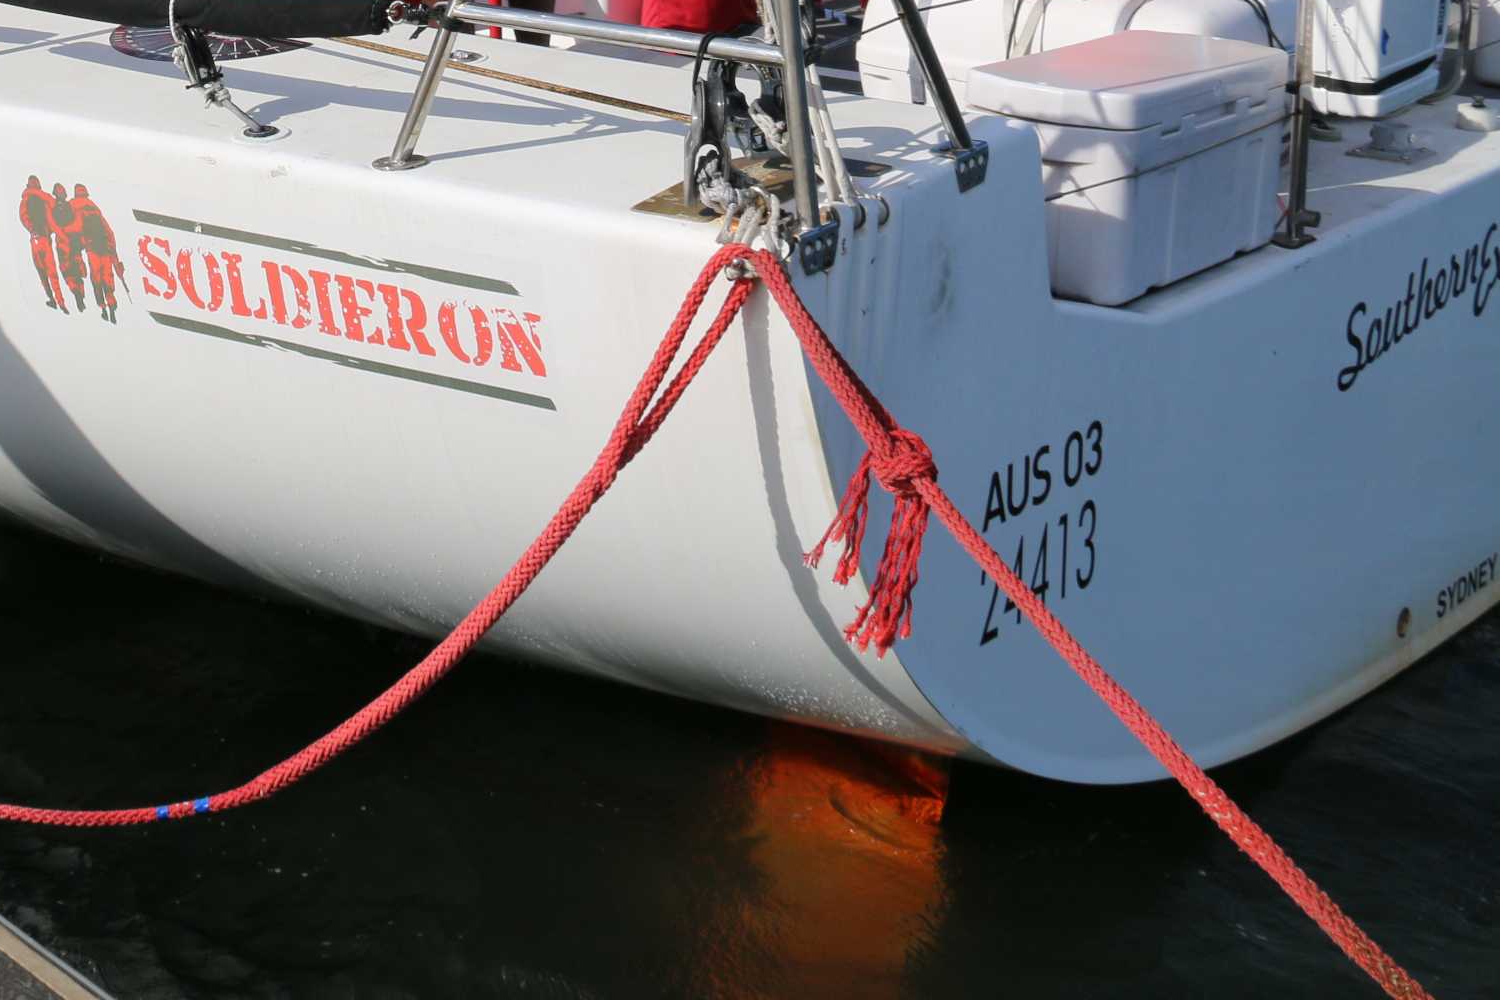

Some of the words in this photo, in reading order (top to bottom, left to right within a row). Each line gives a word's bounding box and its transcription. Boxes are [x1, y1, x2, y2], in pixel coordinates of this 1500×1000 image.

[982, 445, 1052, 533] AUS
[1063, 420, 1103, 487] 03
[1436, 551, 1498, 618] SYDNEY
